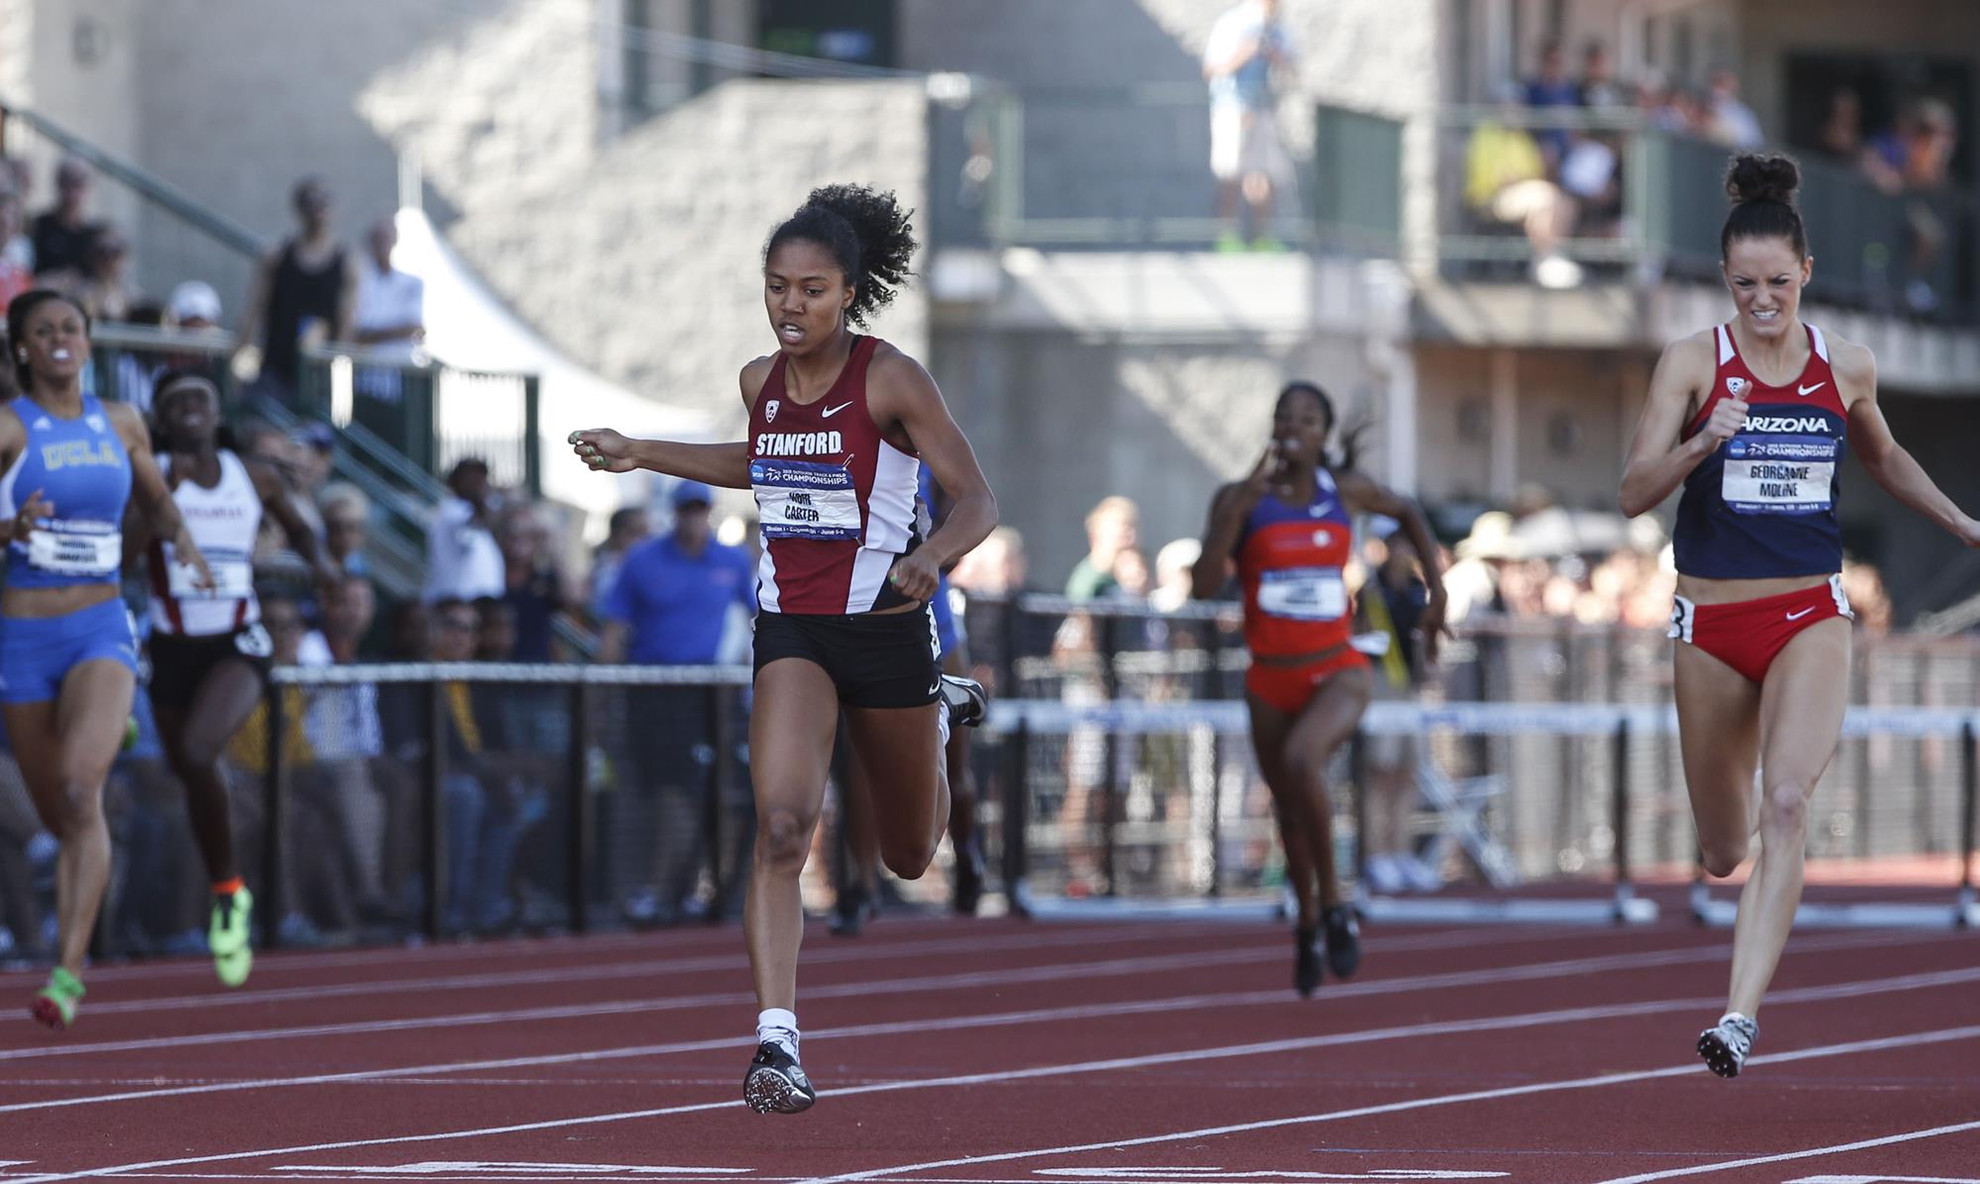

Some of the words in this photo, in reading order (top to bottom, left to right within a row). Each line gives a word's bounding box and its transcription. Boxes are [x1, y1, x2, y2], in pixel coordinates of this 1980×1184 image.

[1742, 416, 1828, 433] ARIZONA
[755, 430, 841, 456] STANFORD
[41, 440, 121, 471] UCLA
[782, 474, 848, 485] CHAMPIONSHIPS
[1760, 482, 1798, 497] MOLINE
[785, 505, 819, 522] CARTER
